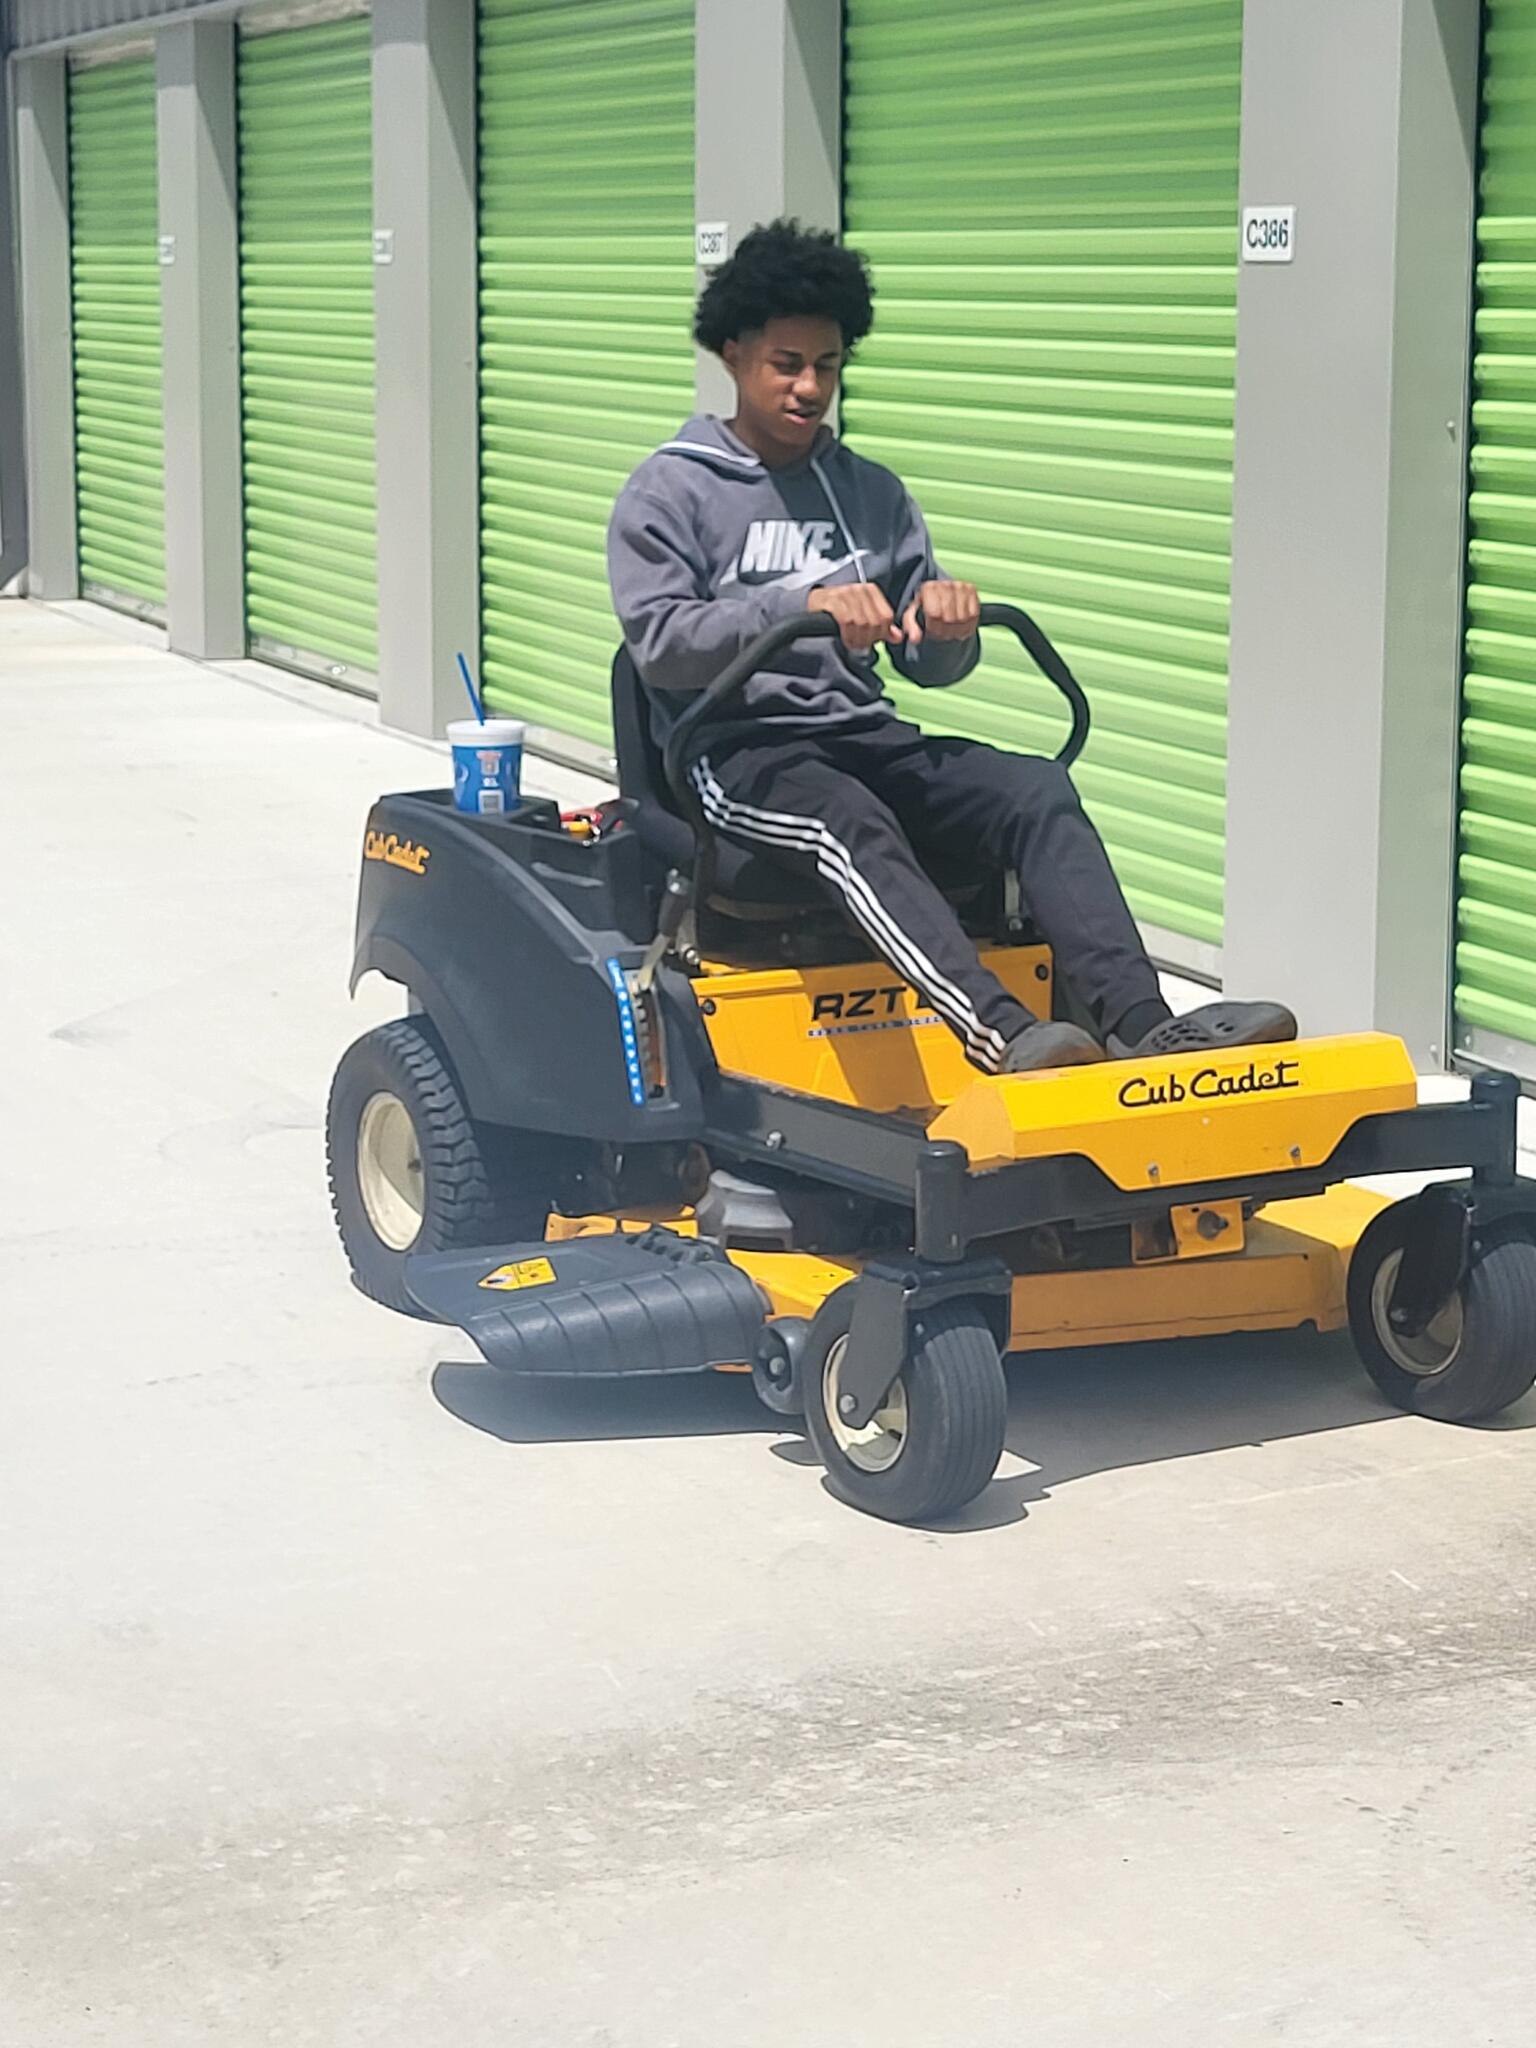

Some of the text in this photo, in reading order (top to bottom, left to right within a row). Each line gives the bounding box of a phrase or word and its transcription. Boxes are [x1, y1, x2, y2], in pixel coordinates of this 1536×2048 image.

[1246, 218, 1289, 249] C386
[740, 519, 836, 573] NIKE
[811, 986, 907, 1021] RZT
[1118, 1060, 1299, 1108] Cub Cadet
